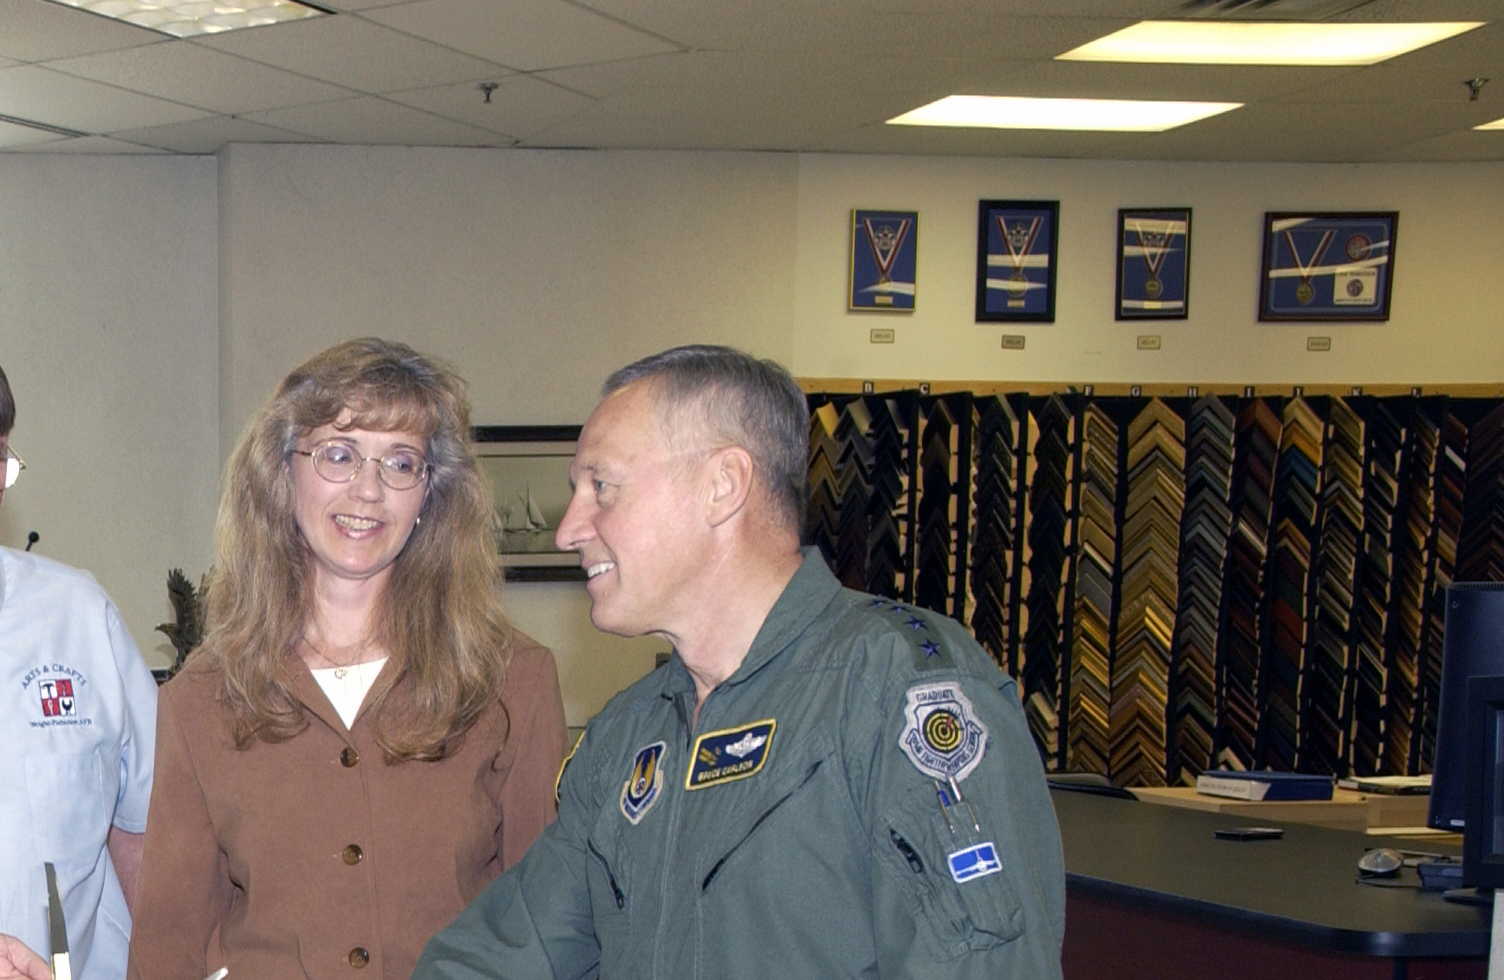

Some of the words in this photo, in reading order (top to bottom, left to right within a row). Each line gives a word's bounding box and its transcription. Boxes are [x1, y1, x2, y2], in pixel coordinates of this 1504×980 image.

[22, 667, 41, 690] ARTS
[42, 665, 49, 673] &
[52, 664, 87, 687] CRAFTS
[916, 689, 955, 702] GRADUATE
